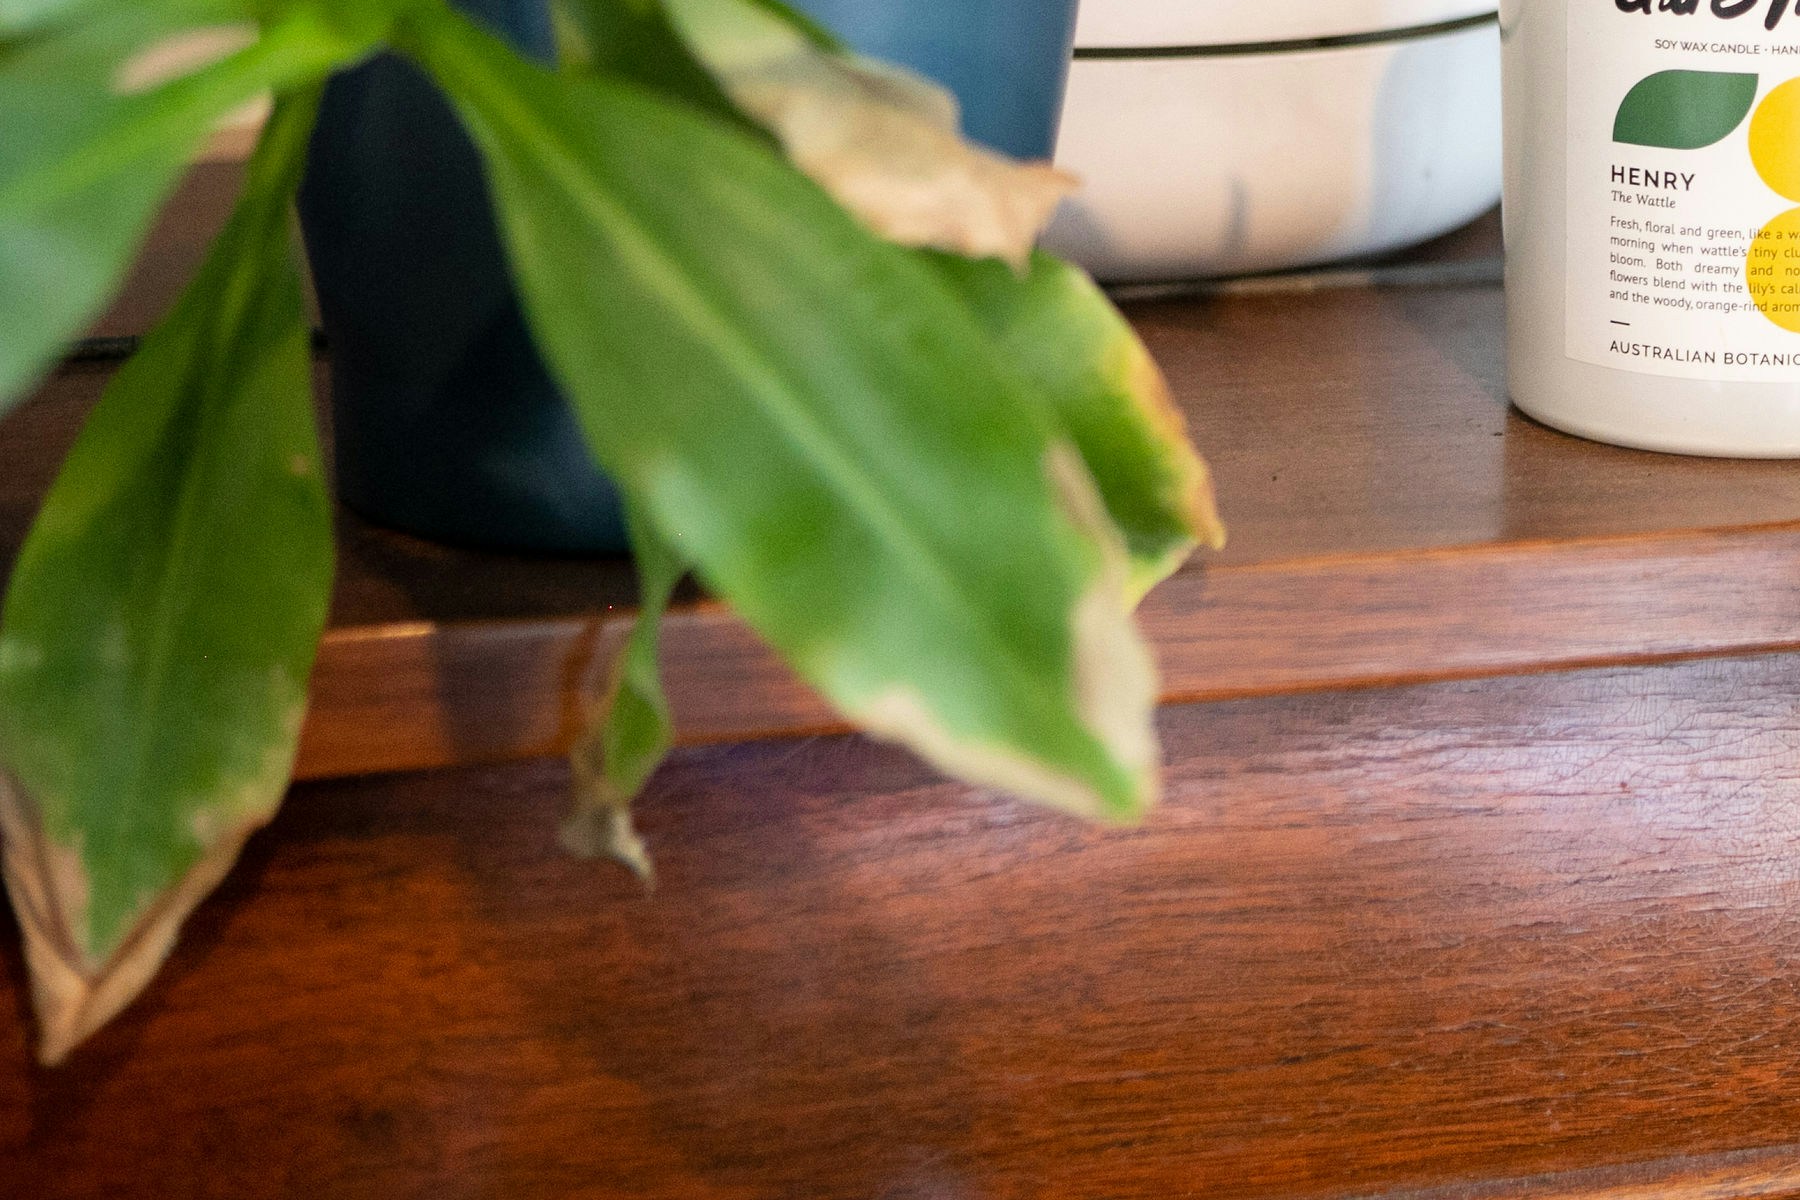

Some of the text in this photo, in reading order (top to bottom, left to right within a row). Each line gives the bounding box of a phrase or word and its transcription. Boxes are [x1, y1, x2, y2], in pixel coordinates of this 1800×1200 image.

[1655, 39, 1677, 50] SOY
[1680, 41, 1709, 52] WAX
[1711, 42, 1760, 54] CANDLE
[1611, 165, 1695, 191] HENRY
[1611, 191, 1676, 208] The Wattle
[1610, 216, 1642, 233] Fresh,
[1645, 221, 1675, 235] floral
[1680, 224, 1702, 237] and
[1707, 229, 1745, 240] green,
[1749, 228, 1770, 240] like
[1776, 232, 1782, 240] a
[1610, 236, 1655, 253] morning
[1662, 242, 1693, 254] when
[1700, 245, 1747, 257] wattle's
[1754, 246, 1777, 260] tiny
[1610, 252, 1645, 268] bloom.
[1656, 258, 1683, 272] Both
[1694, 263, 1739, 278] dreamy
[1750, 264, 1773, 276] and
[1610, 270, 1648, 286] flowers
[1653, 276, 1686, 290] blend
[1691, 280, 1718, 292] with
[1723, 282, 1742, 293] the
[1749, 282, 1775, 296] lily's
[1610, 288, 1628, 302] and
[1632, 292, 1650, 304] the
[1653, 295, 1693, 310] woody,
[1696, 298, 1767, 313] orange-rind
[1610, 340, 1716, 363] AUSTRALIAN
